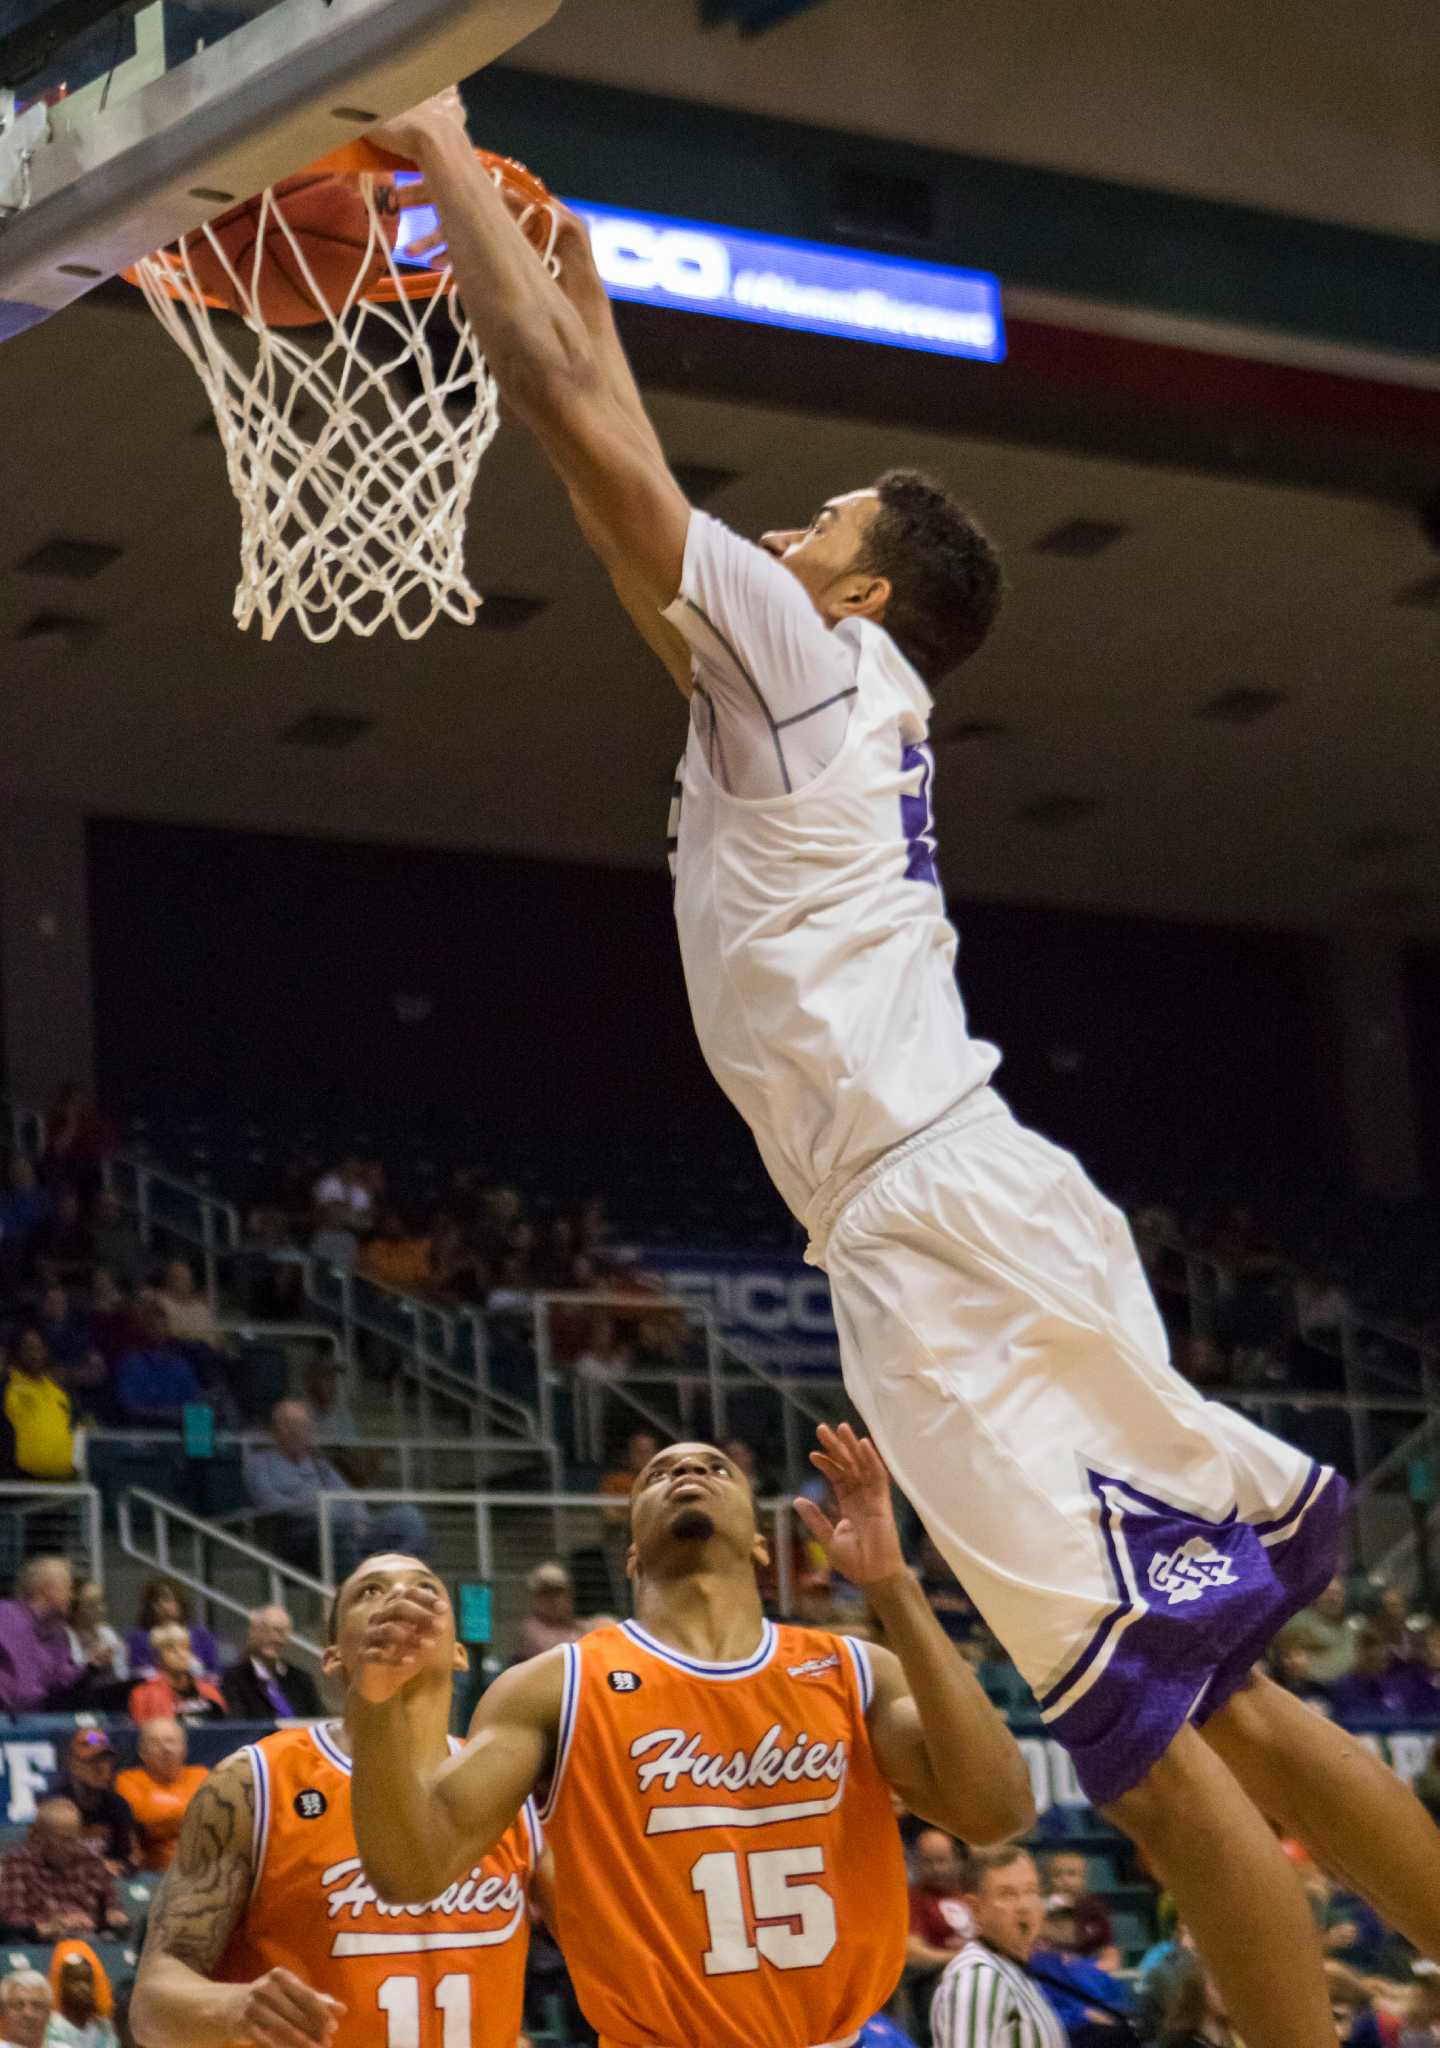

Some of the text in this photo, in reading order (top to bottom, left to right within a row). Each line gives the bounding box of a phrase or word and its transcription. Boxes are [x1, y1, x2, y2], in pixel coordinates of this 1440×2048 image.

[630, 1724, 847, 1793] Huskies
[690, 1845, 837, 1976] 15
[377, 1973, 471, 2048] 11
